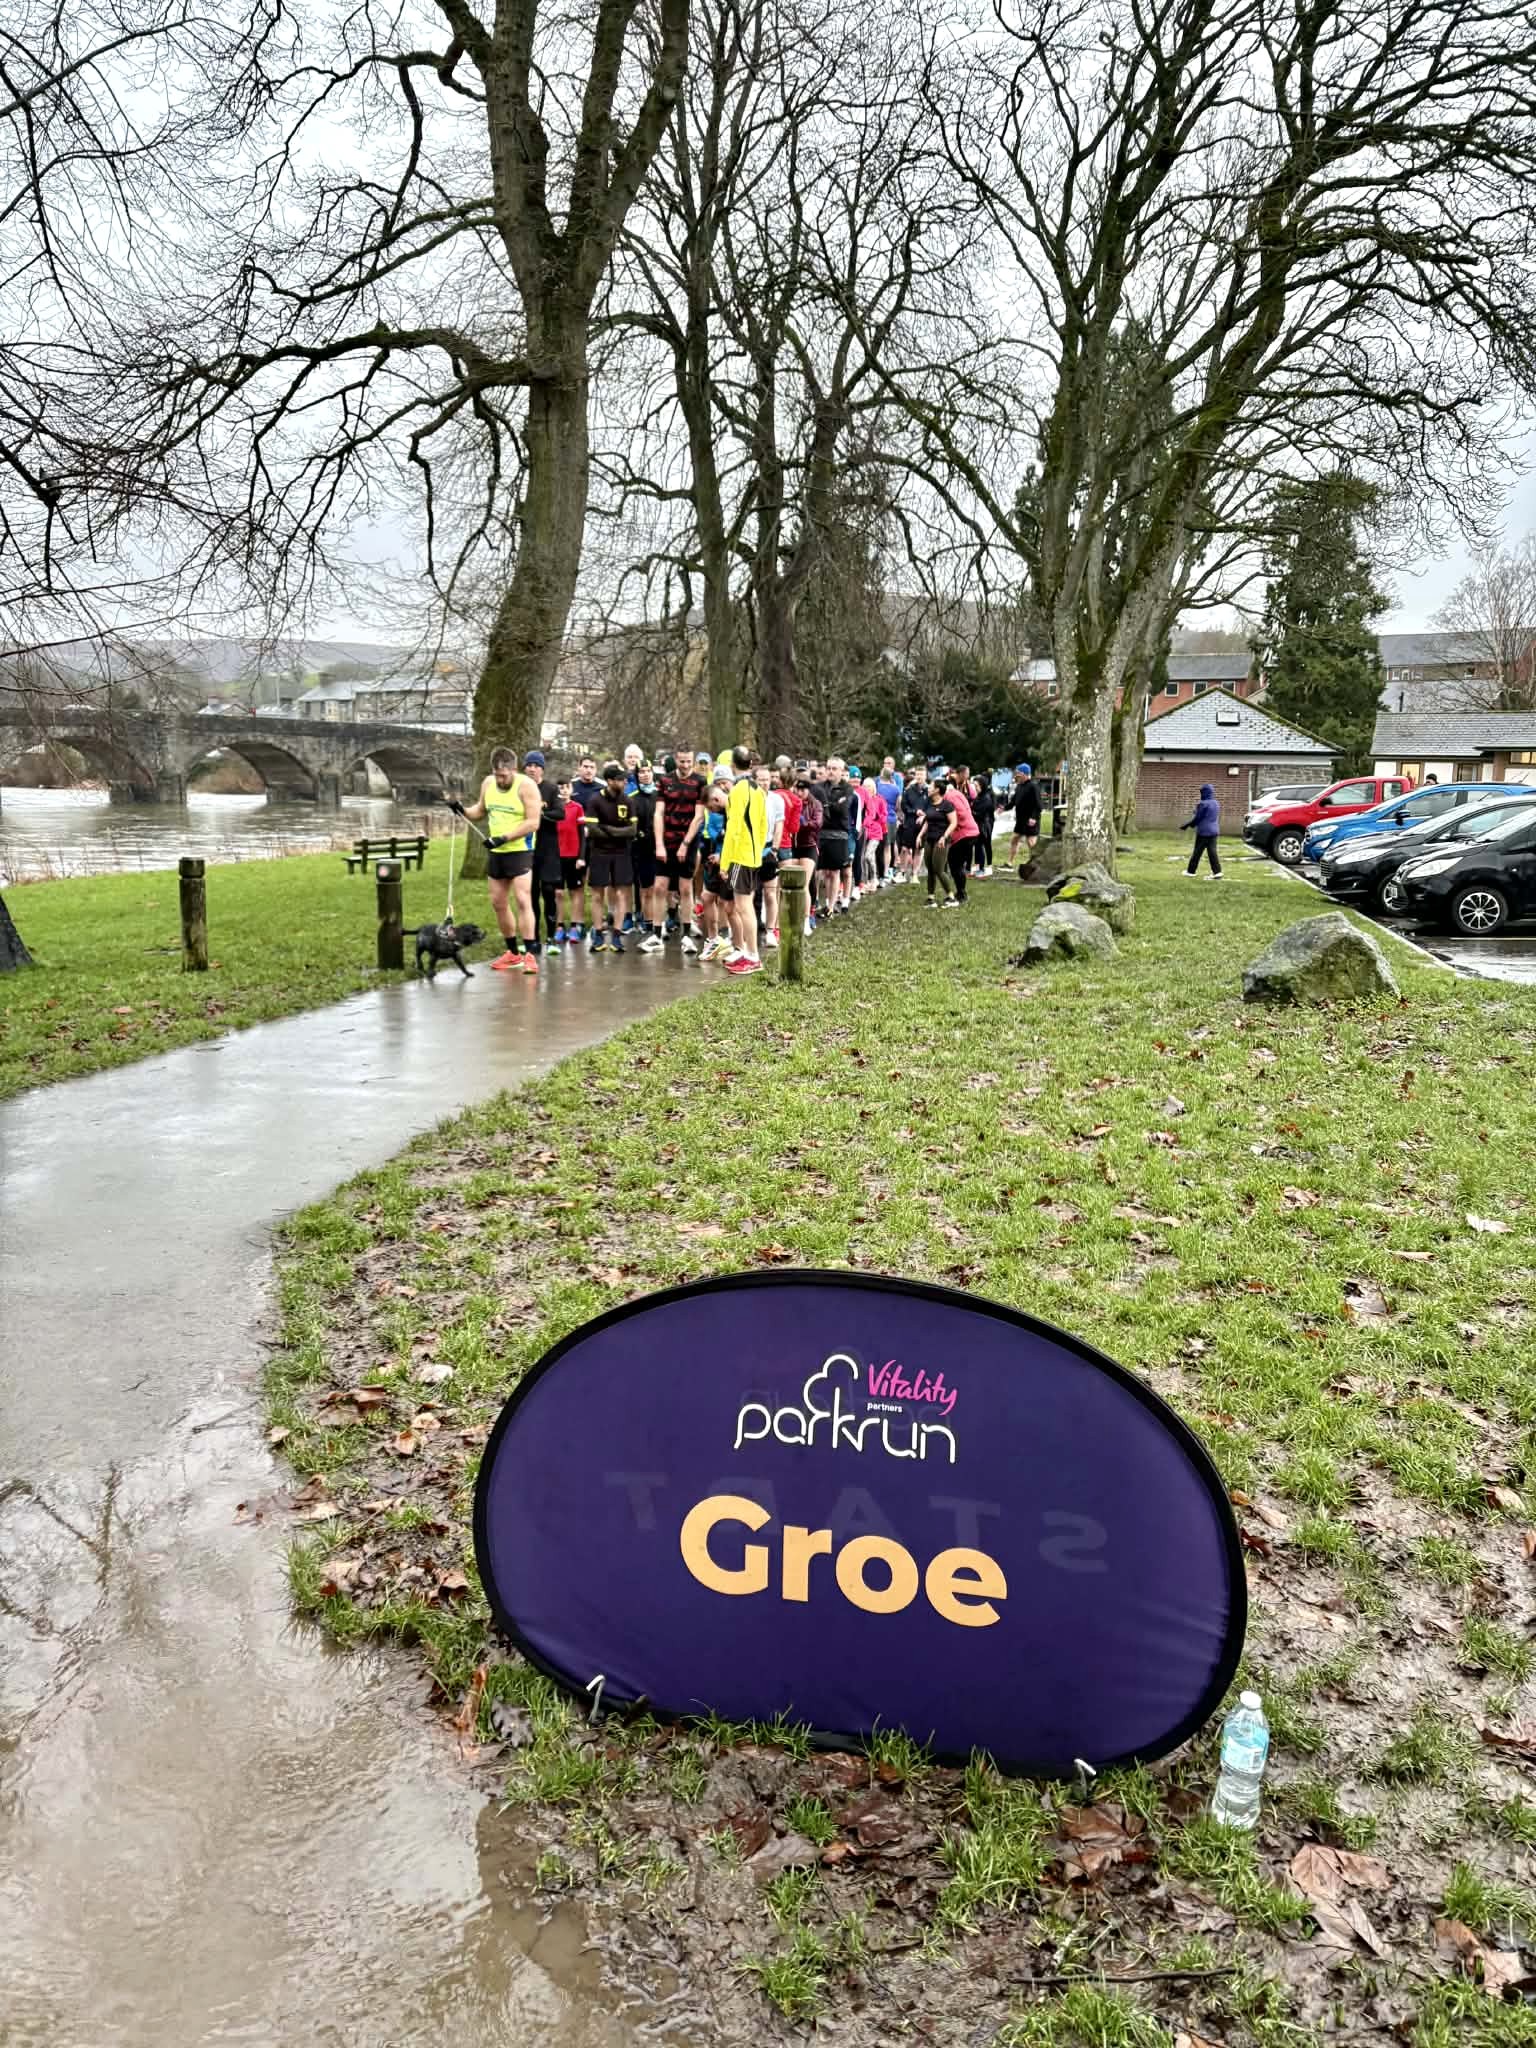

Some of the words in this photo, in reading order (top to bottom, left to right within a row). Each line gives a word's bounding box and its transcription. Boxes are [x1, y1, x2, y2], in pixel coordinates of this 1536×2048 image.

[733, 1354, 956, 1464] parkrun
[866, 1402, 903, 1413] partners
[868, 1359, 958, 1416] Vitality
[680, 1495, 1008, 1627] Groe
